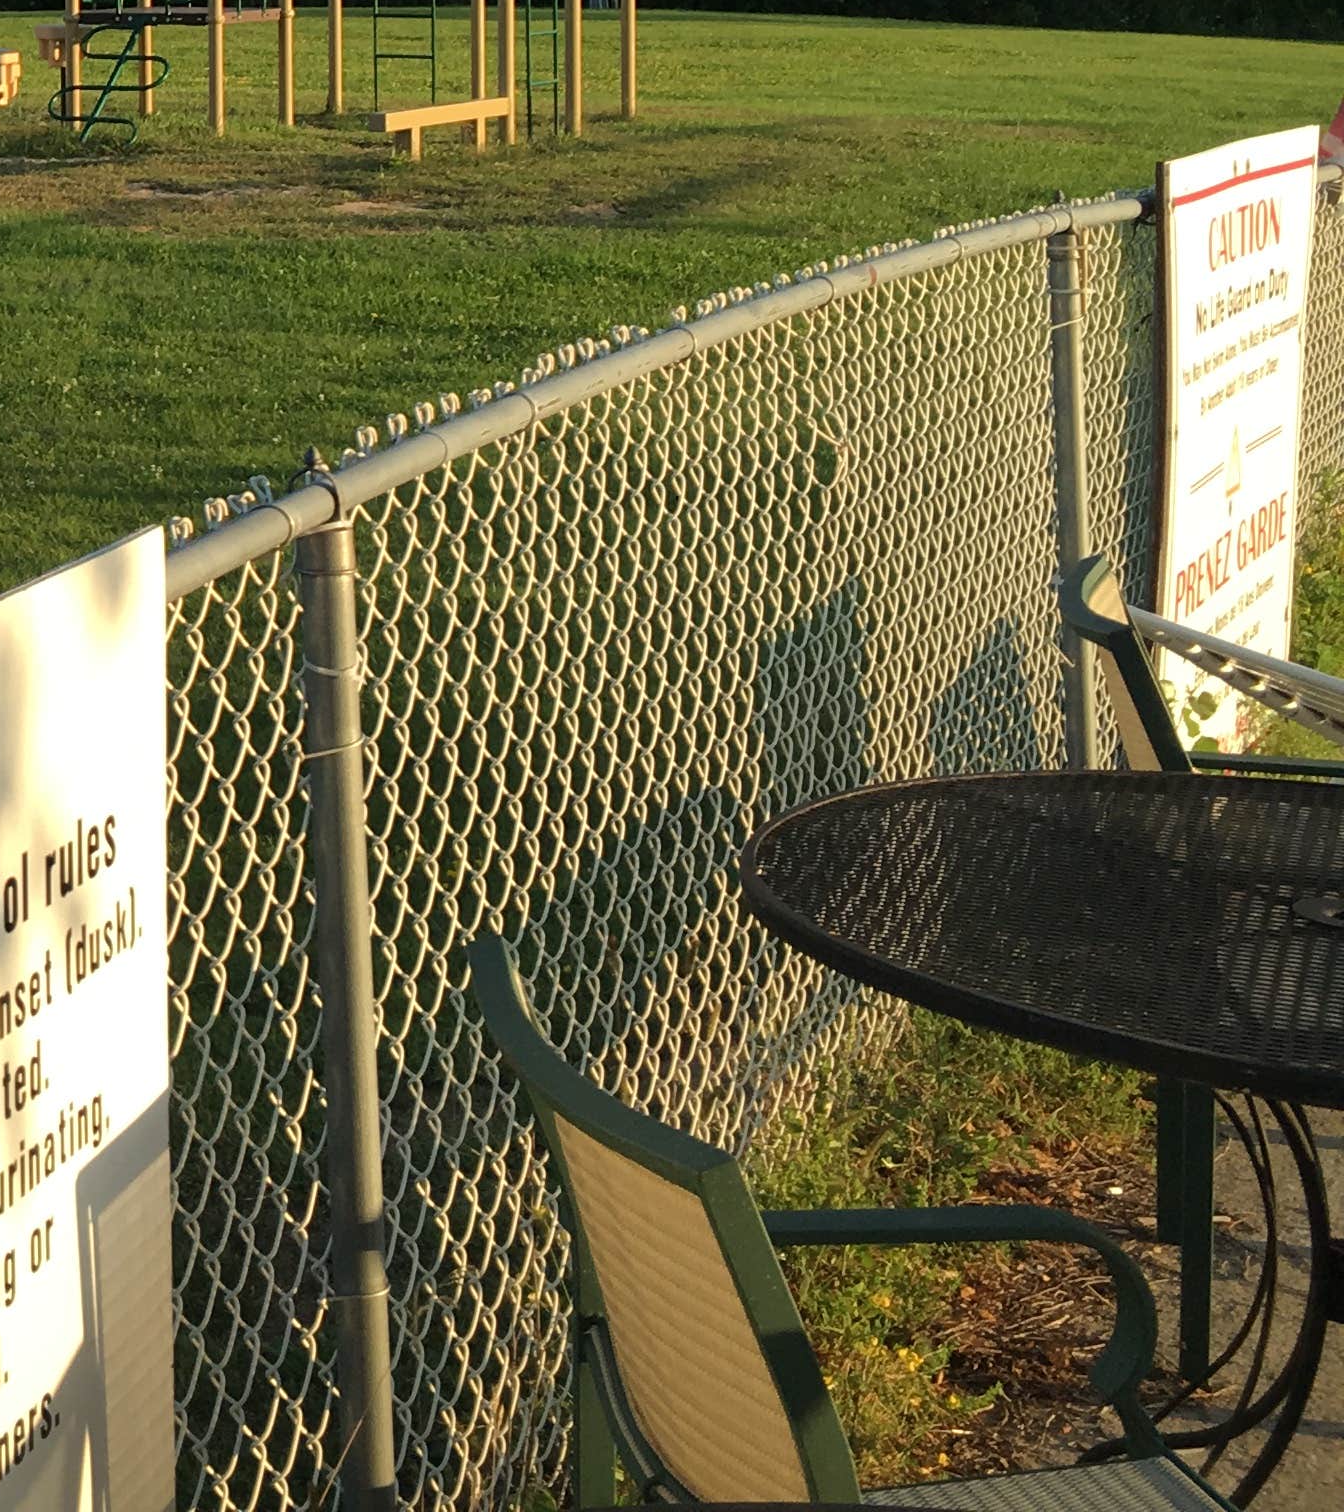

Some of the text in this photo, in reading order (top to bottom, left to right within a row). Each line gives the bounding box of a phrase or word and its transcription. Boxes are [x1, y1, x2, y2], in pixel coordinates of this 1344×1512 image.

[1208, 197, 1281, 272] CAUTION
[1195, 302, 1208, 336] No
[1228, 277, 1252, 319] Guard
[1255, 280, 1265, 305] on
[1269, 267, 1289, 302] Duty
[1175, 491, 1288, 623] PRENEZ GARDE
[44, 813, 117, 907] rules
[64, 887, 143, 996] (dusk).
[30, 1216, 54, 1274] or
